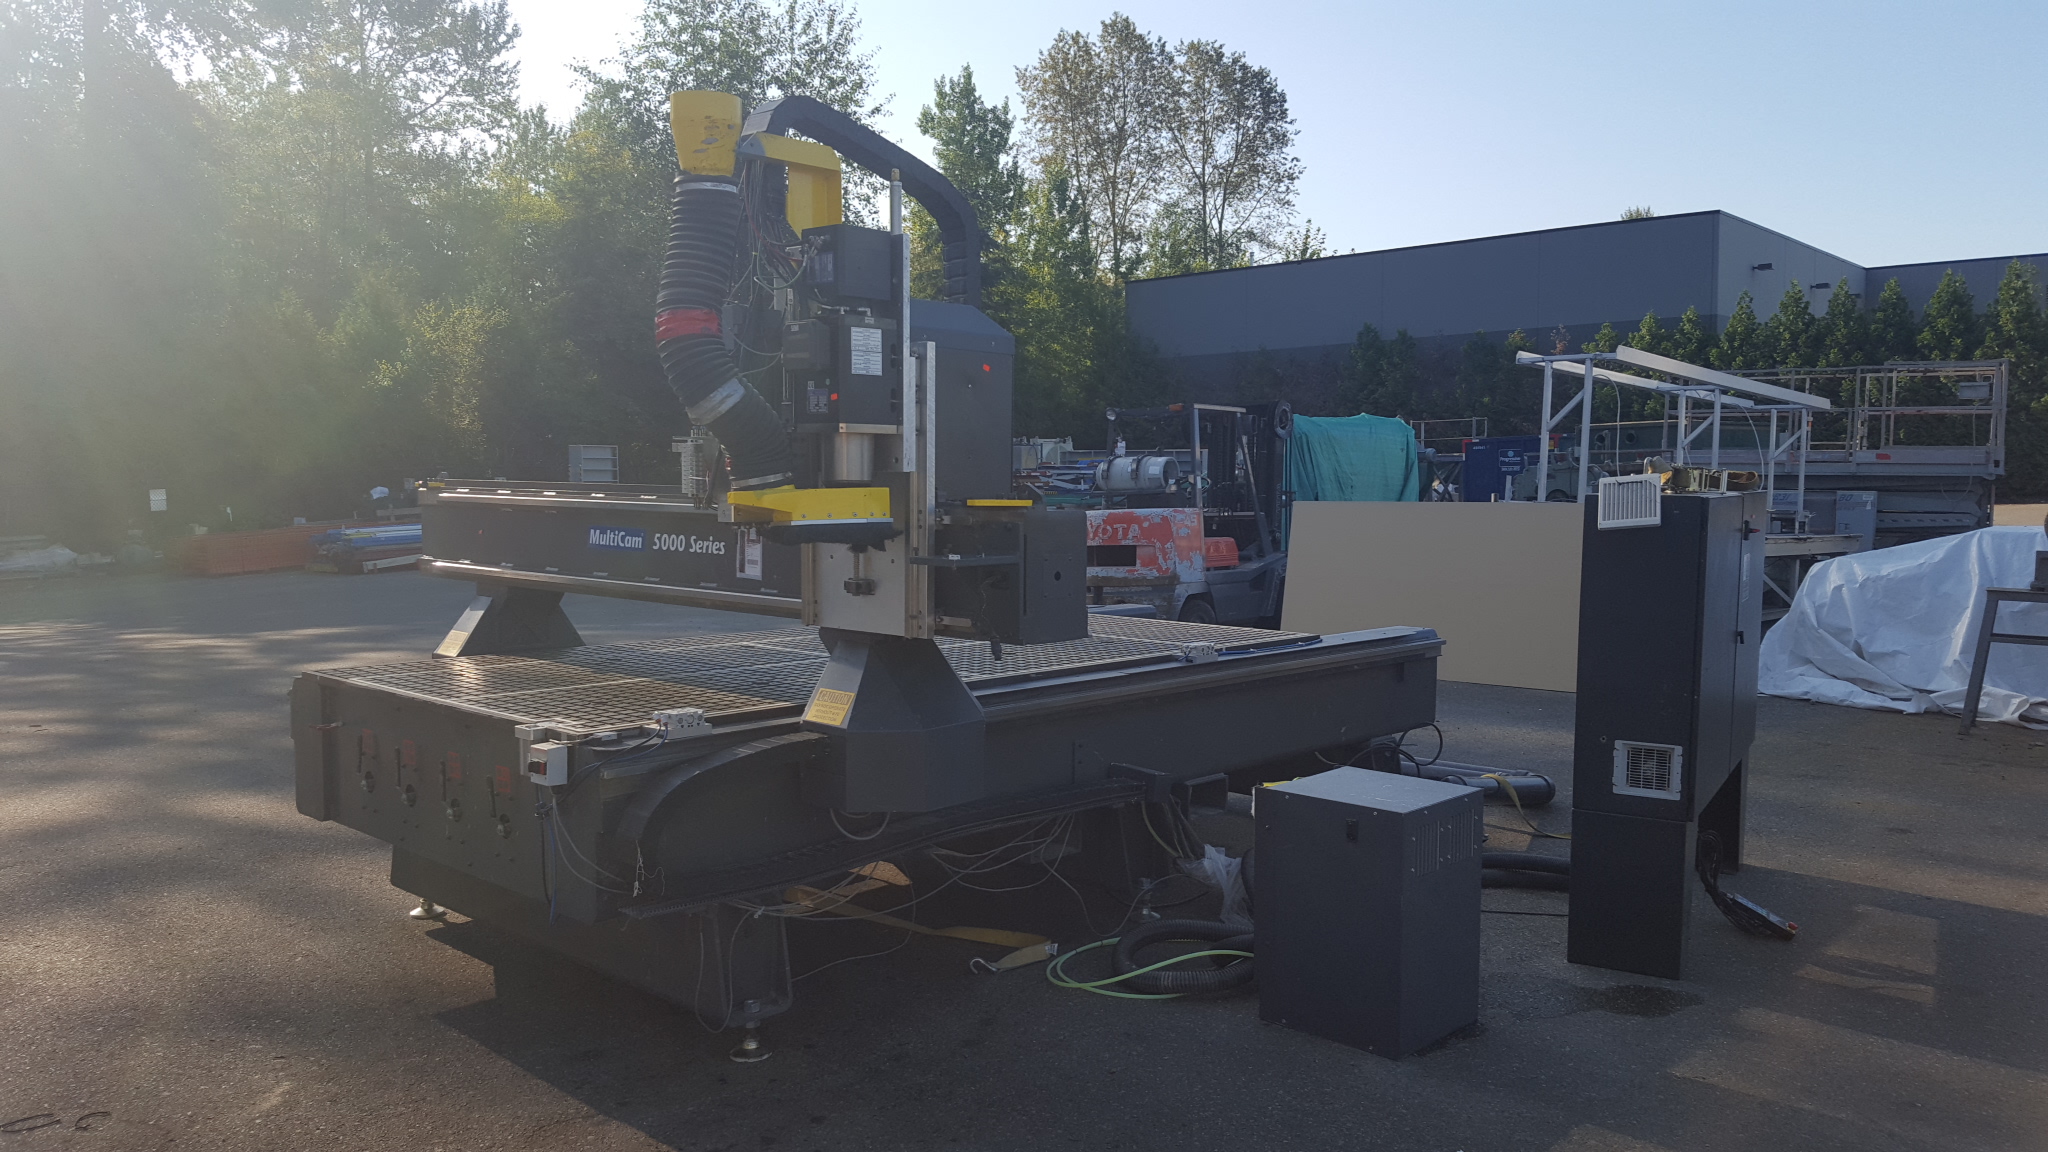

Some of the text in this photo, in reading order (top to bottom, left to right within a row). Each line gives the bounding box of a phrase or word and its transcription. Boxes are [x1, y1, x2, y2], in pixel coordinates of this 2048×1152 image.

[1087, 522, 1140, 540] YOTA
[589, 529, 725, 554] MultiCam 5000 Series
[819, 690, 850, 705] CAUTION
